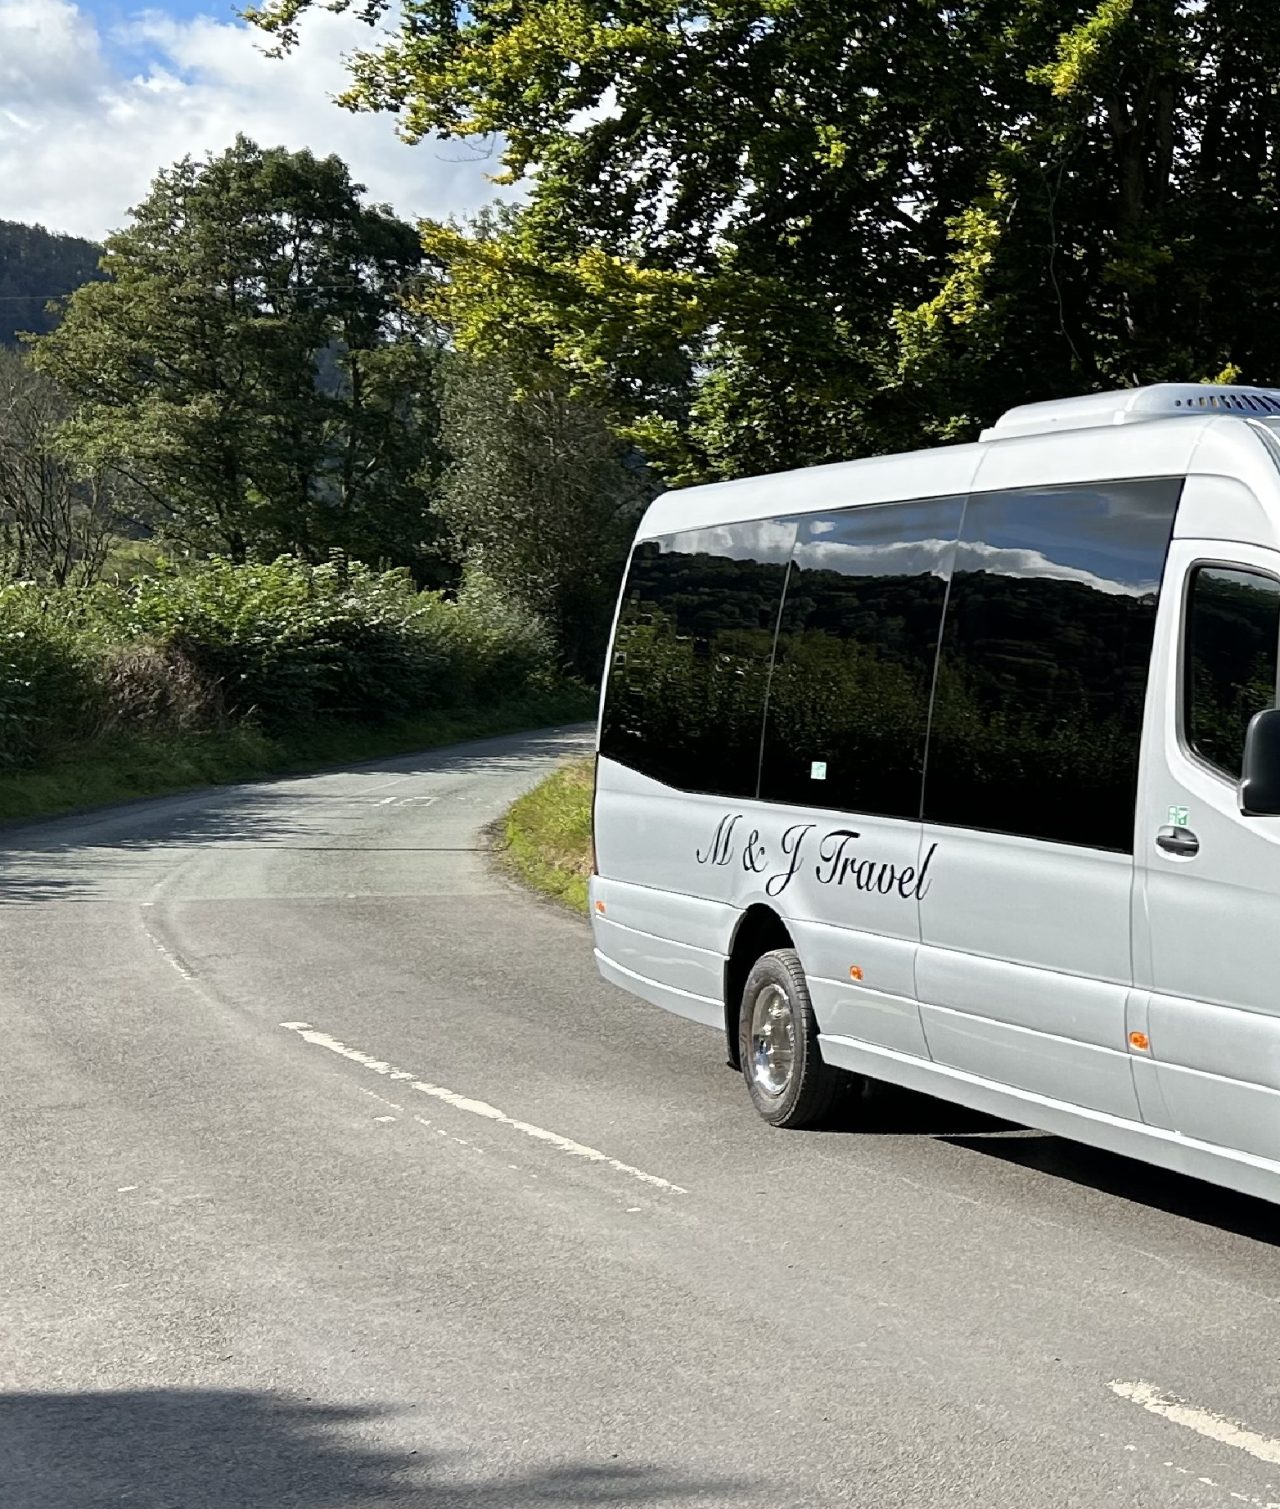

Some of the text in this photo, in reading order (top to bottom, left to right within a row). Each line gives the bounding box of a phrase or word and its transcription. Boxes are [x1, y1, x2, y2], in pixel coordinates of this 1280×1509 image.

[696, 813, 938, 901] M & J Travel
